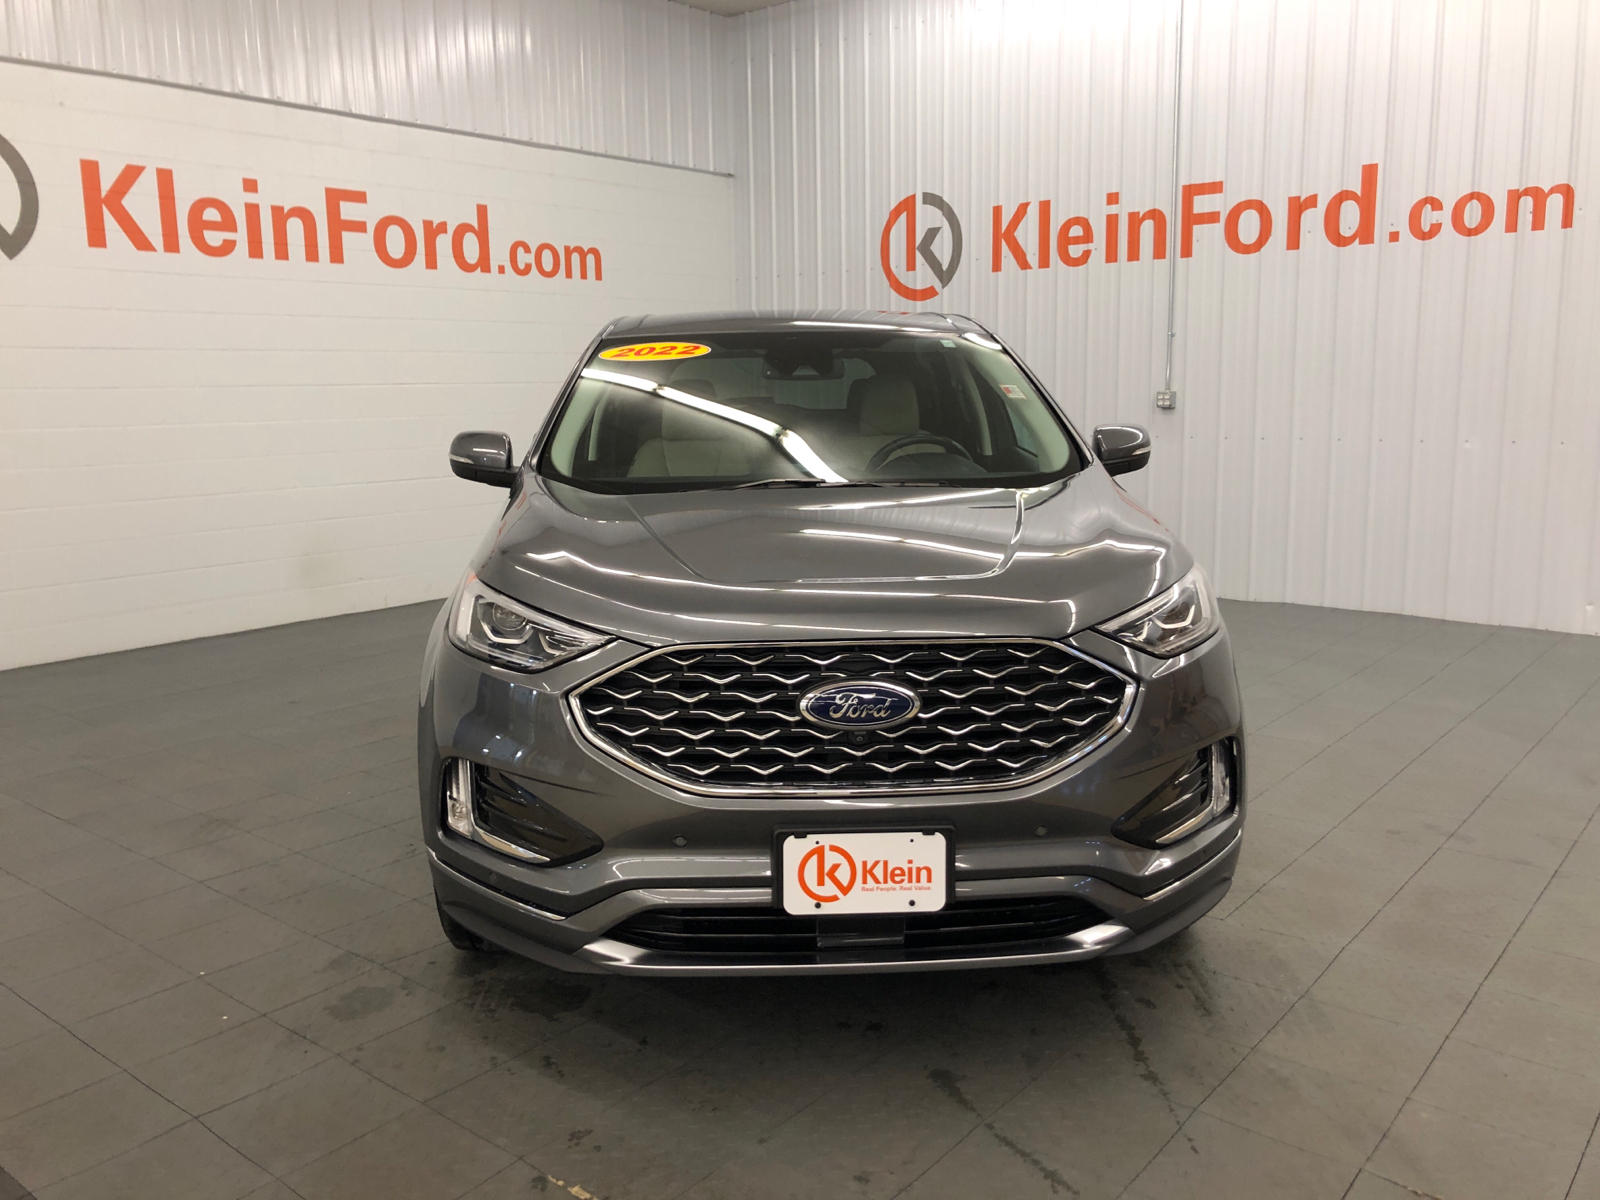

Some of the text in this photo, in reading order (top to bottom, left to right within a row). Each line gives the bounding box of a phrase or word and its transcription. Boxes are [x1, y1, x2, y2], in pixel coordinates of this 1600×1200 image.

[79, 158, 603, 281] KleinFord.com
[991, 163, 1575, 273] KleinFord.com
[610, 345, 701, 358] 2022
[828, 692, 894, 718] Ford
[861, 859, 932, 884] Klein
